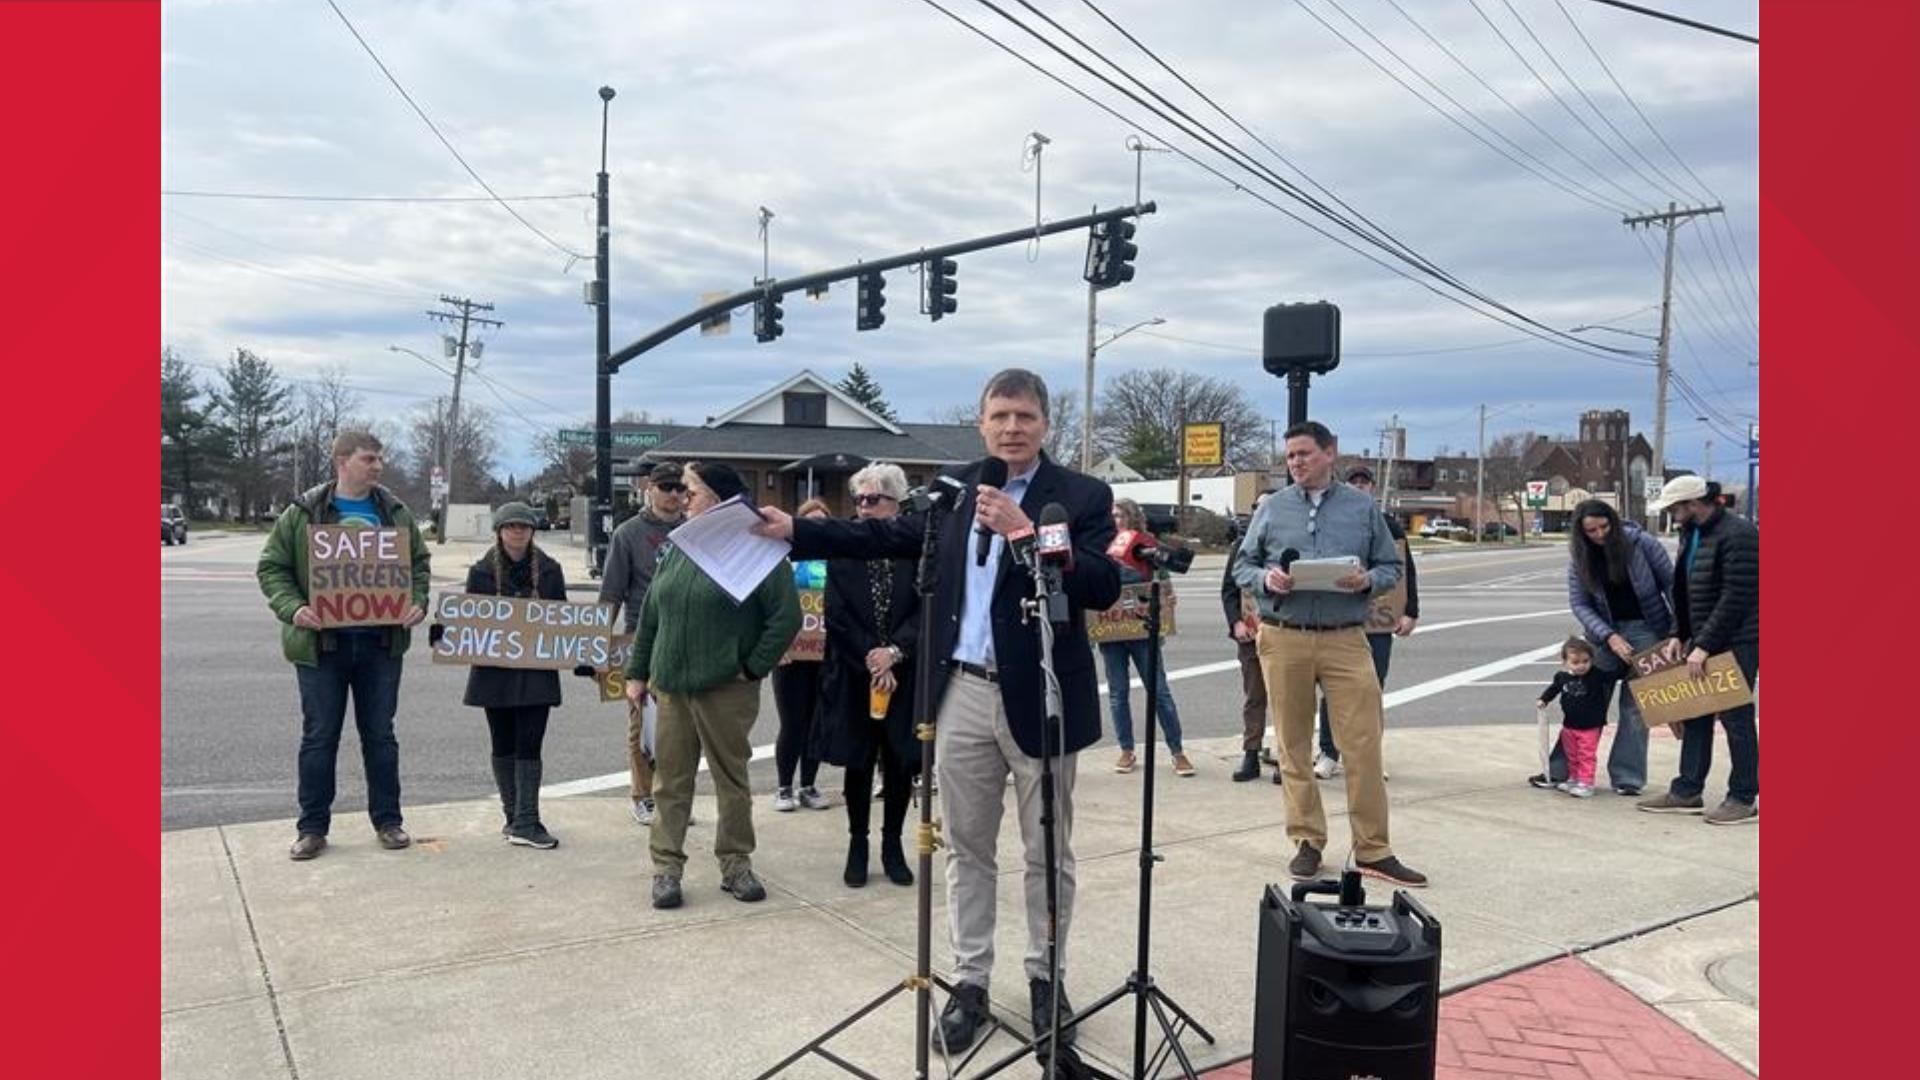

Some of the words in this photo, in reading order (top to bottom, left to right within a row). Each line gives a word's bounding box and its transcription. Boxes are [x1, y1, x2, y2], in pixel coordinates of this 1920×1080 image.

[313, 531, 399, 559] SAFE
[312, 563, 410, 589] STREETS
[315, 592, 407, 622] NOW
[440, 596, 513, 621] GOOD
[525, 601, 610, 626] DESIGN
[437, 626, 524, 659] SAVES
[535, 631, 609, 664] LIVES
